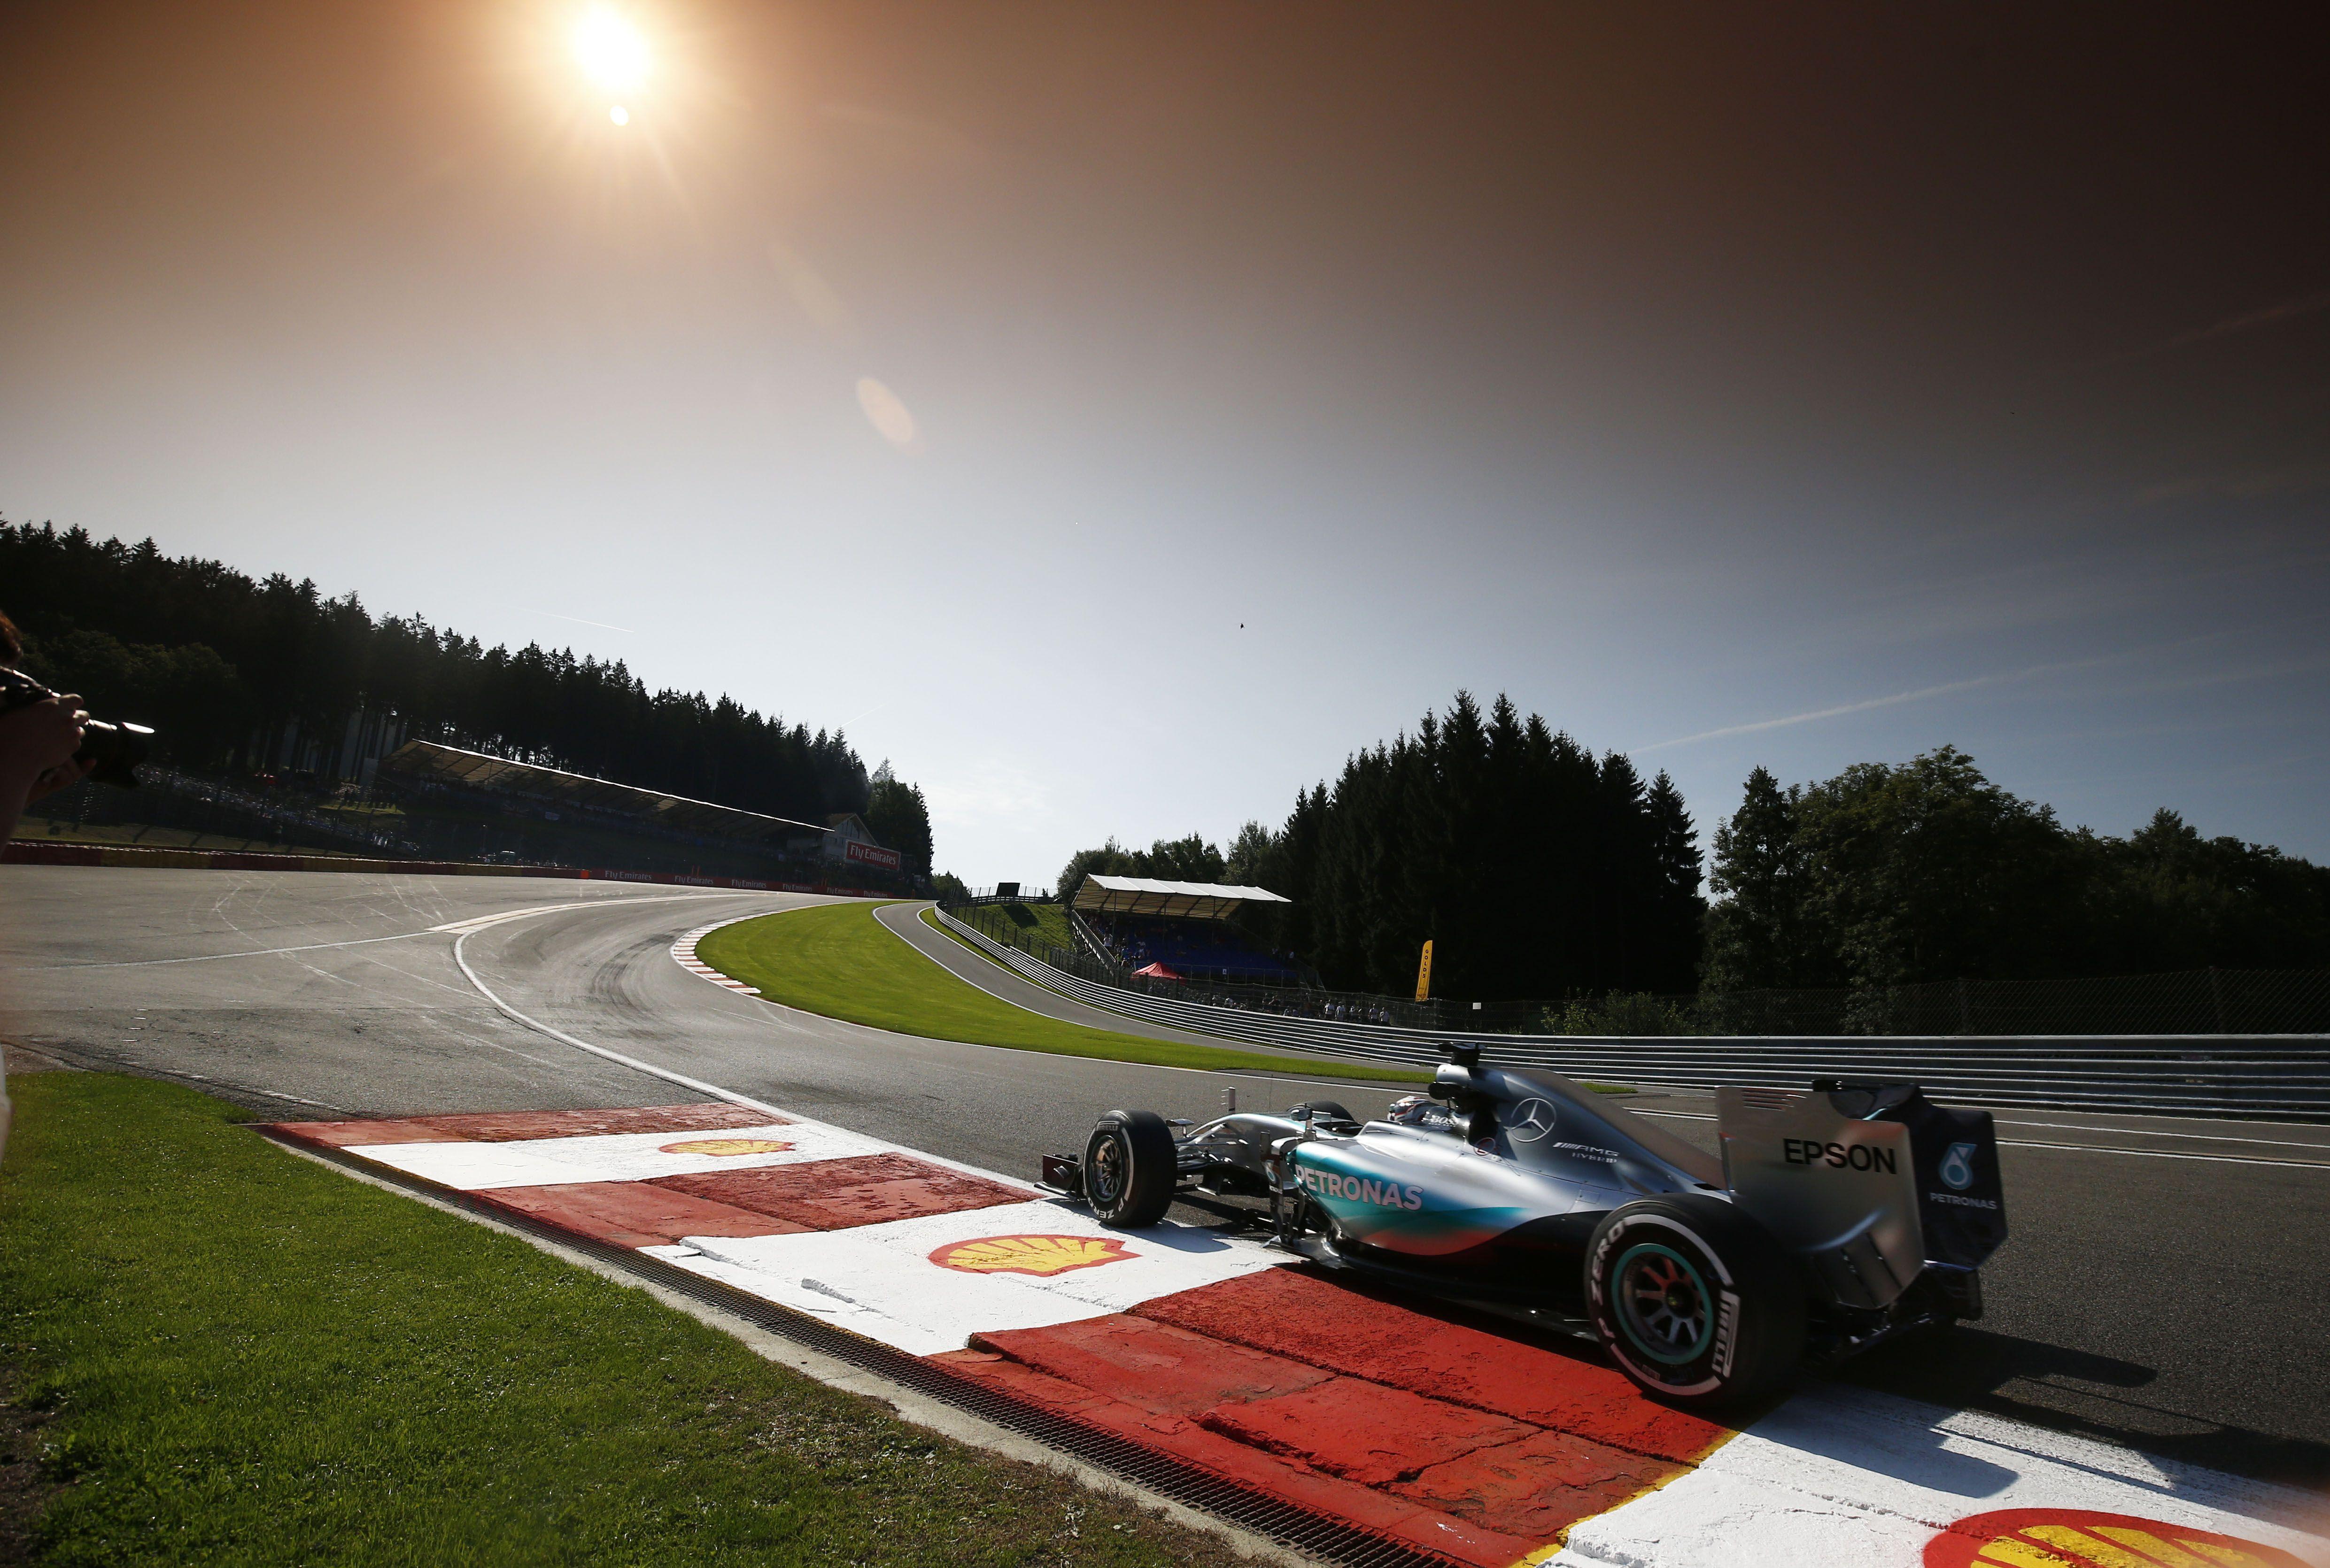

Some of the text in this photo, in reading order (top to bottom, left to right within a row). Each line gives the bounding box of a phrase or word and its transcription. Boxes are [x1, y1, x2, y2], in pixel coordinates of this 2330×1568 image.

[851, 845, 896, 865] Fly Emirates
[605, 870, 652, 880] Fly Emirates
[674, 875, 685, 884] Fly
[731, 879, 741, 888] Fly
[1572, 1152, 1617, 1163] HYBRID
[1575, 1145, 1619, 1157] AMG
[1783, 1138, 1897, 1174] EPSON
[1295, 1164, 1424, 1211] PETRONAS
[1088, 1197, 1115, 1219] ZERO
[1929, 1192, 1997, 1210] PETRONAS
[1590, 1220, 1625, 1306] ZERO
[1711, 1289, 1741, 1378] PIRELLI
